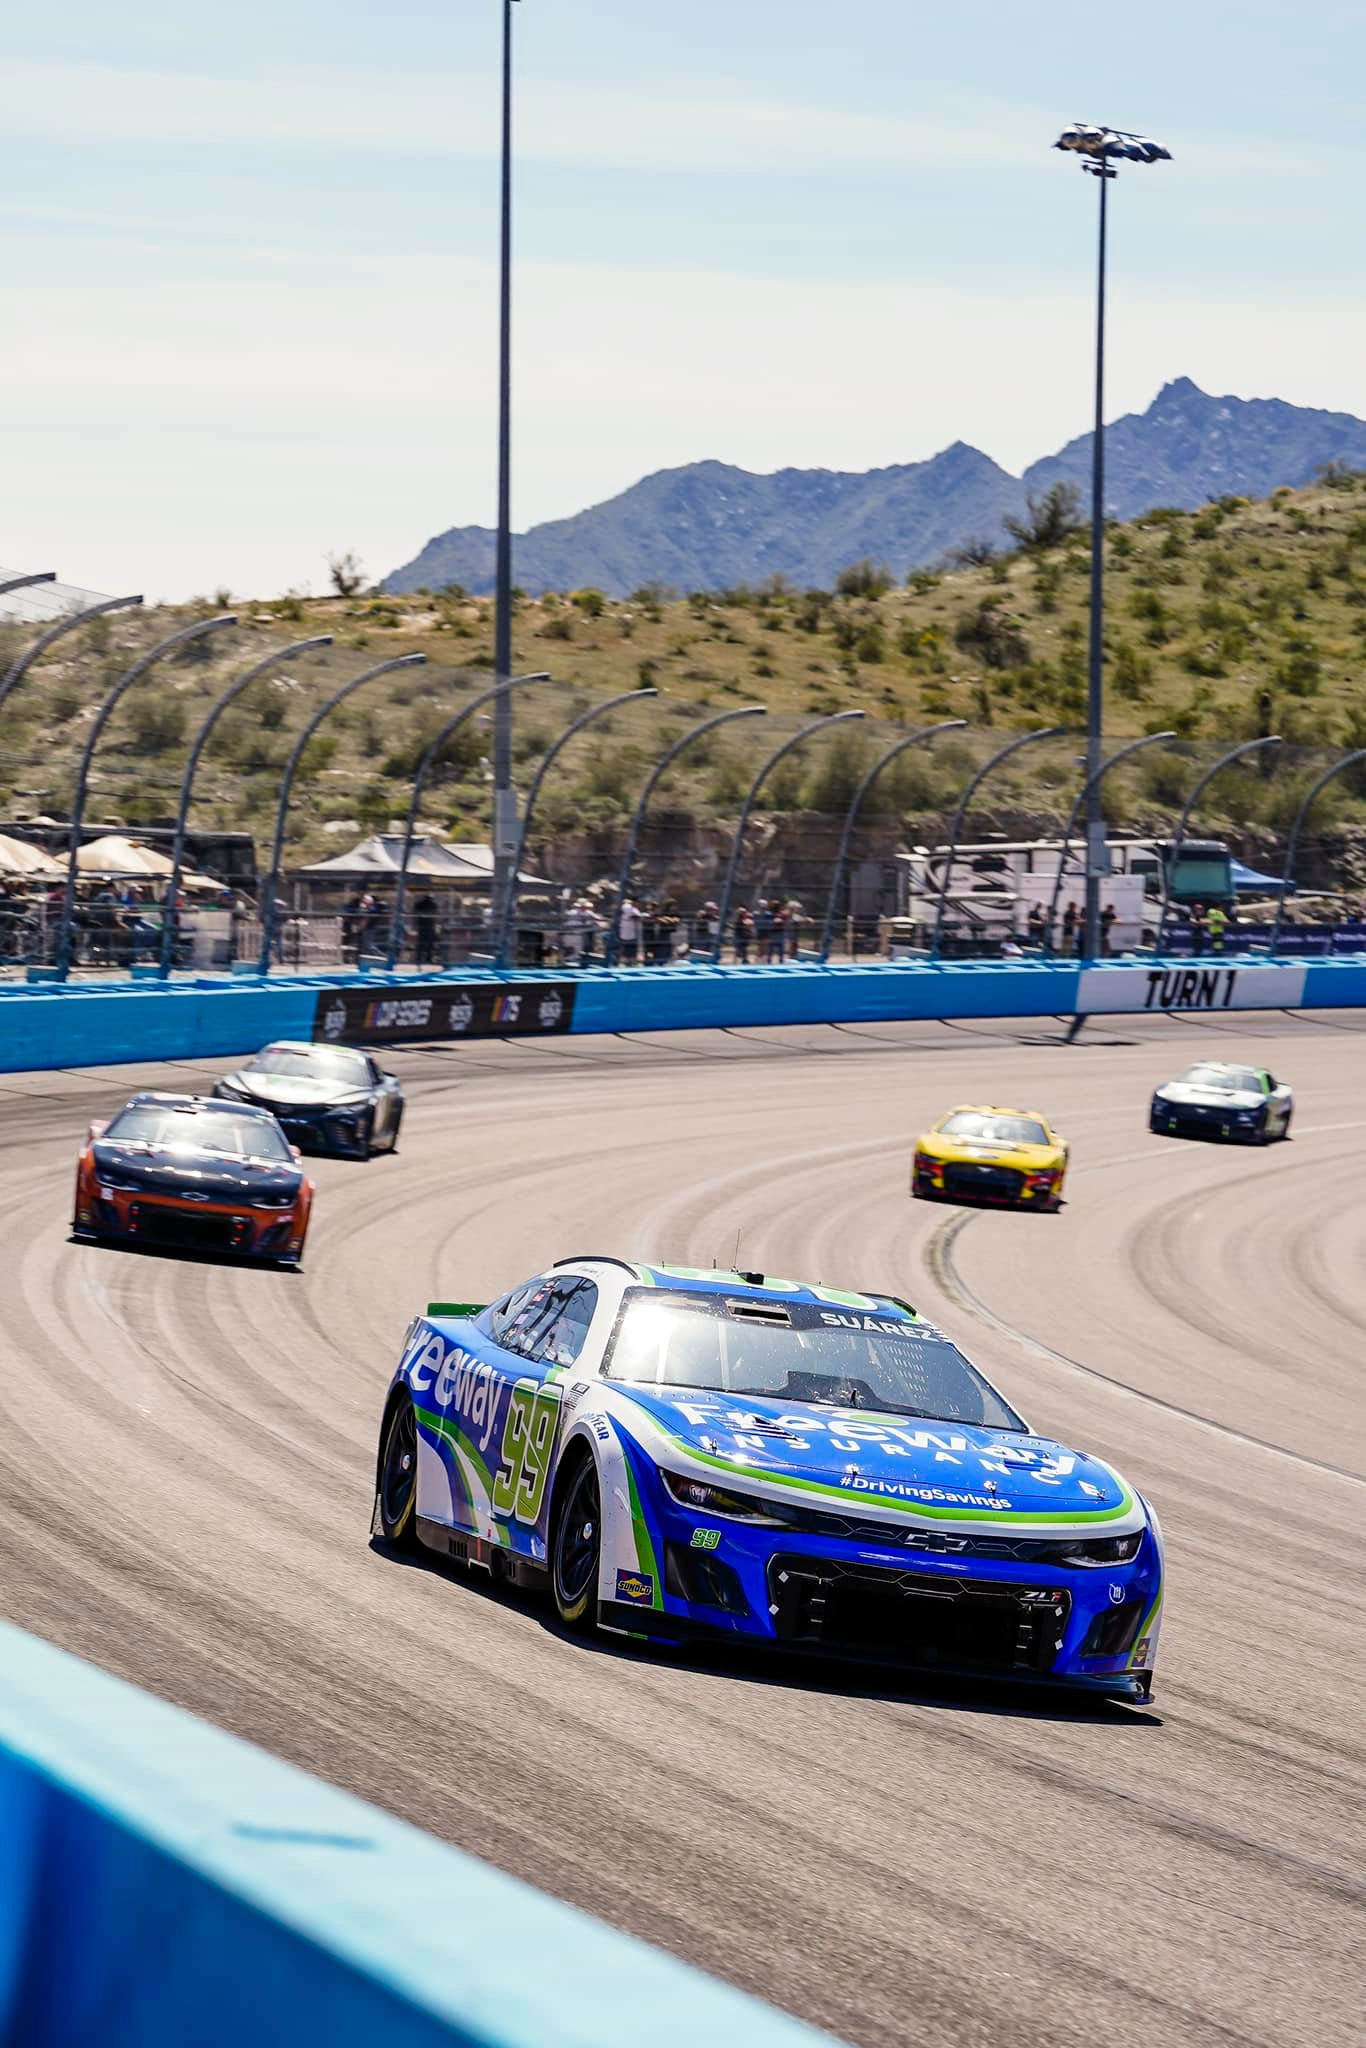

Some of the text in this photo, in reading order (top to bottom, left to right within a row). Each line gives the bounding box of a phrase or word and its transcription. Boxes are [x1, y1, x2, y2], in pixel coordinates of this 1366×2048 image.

[1144, 970, 1237, 1008] TURN 1
[819, 1312, 939, 1343] SUÁREZ
[491, 1377, 564, 1526] 99
[839, 1476, 1012, 1510] #DrivingSavings
[690, 1528, 721, 1550] 99
[618, 1582, 651, 1595] SUNOCO
